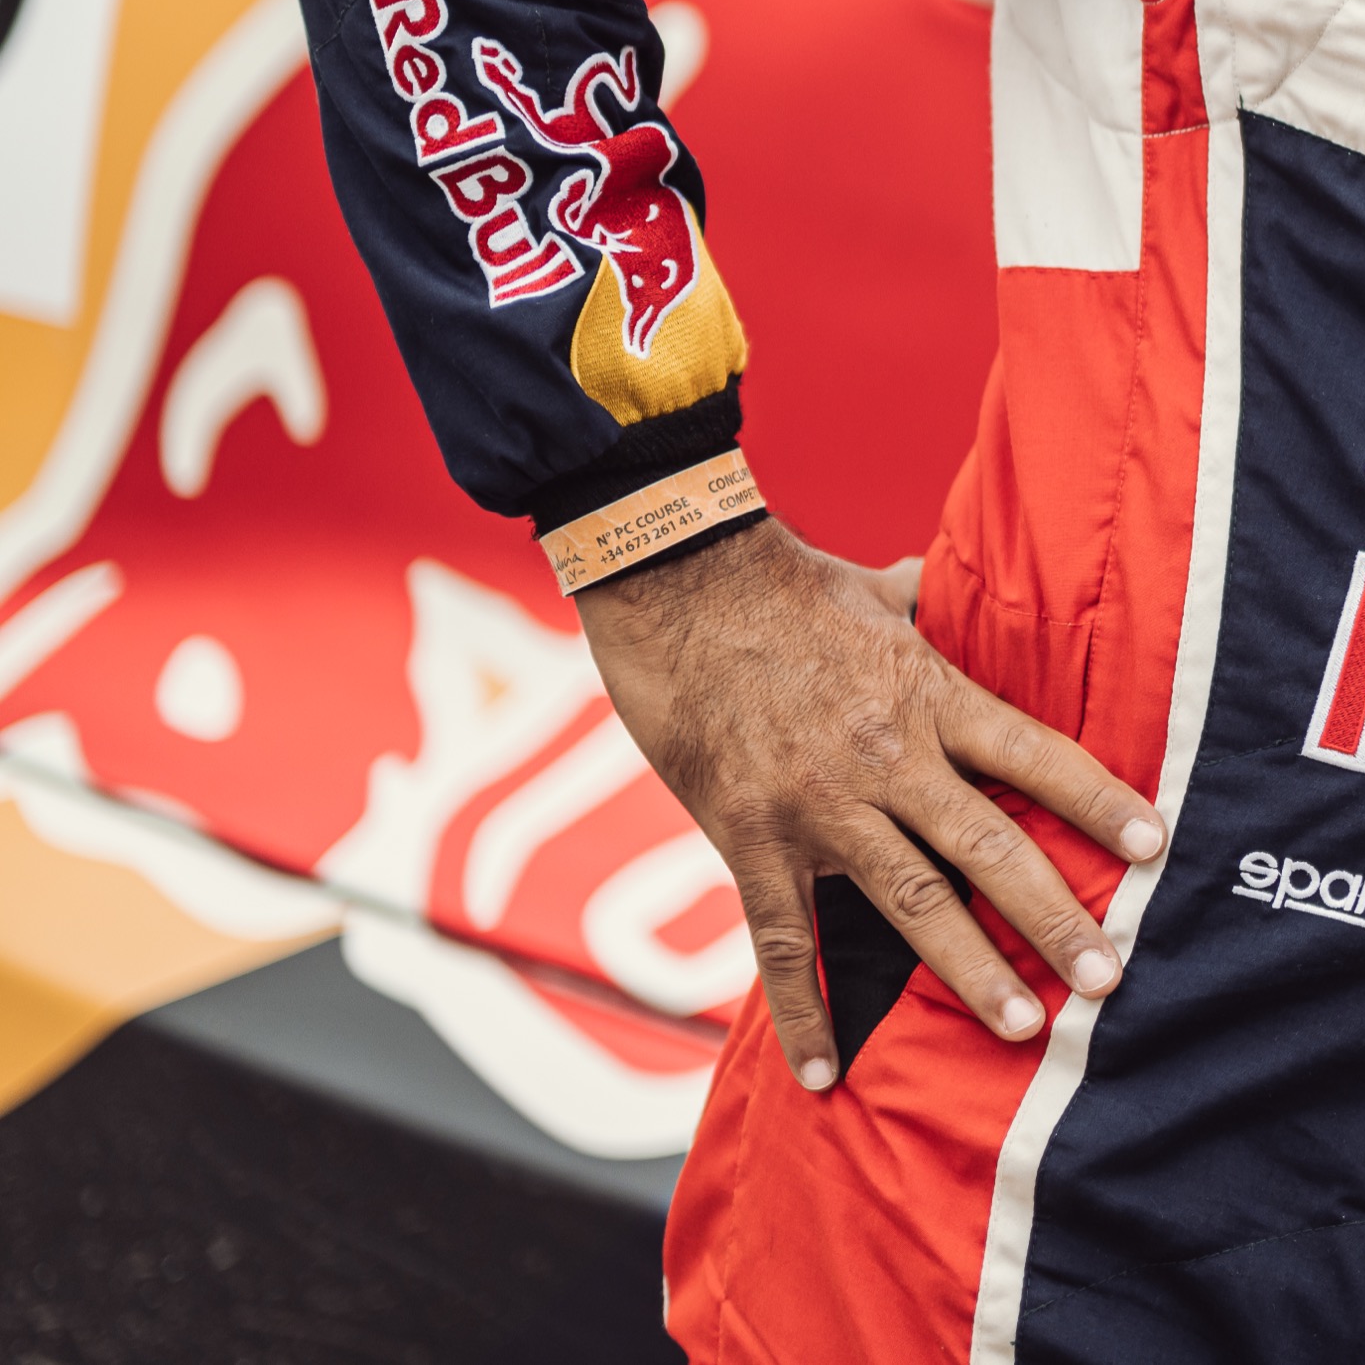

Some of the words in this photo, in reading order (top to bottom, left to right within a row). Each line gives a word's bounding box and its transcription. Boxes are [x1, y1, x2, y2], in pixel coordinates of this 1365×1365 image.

[430, 147, 584, 308] Bull
[600, 545, 624, 564] +34
[625, 534, 651, 552] 673
[654, 522, 676, 540] 261
[679, 508, 703, 526] 415
[615, 521, 634, 540] PC
[635, 497, 690, 528] COURSE
